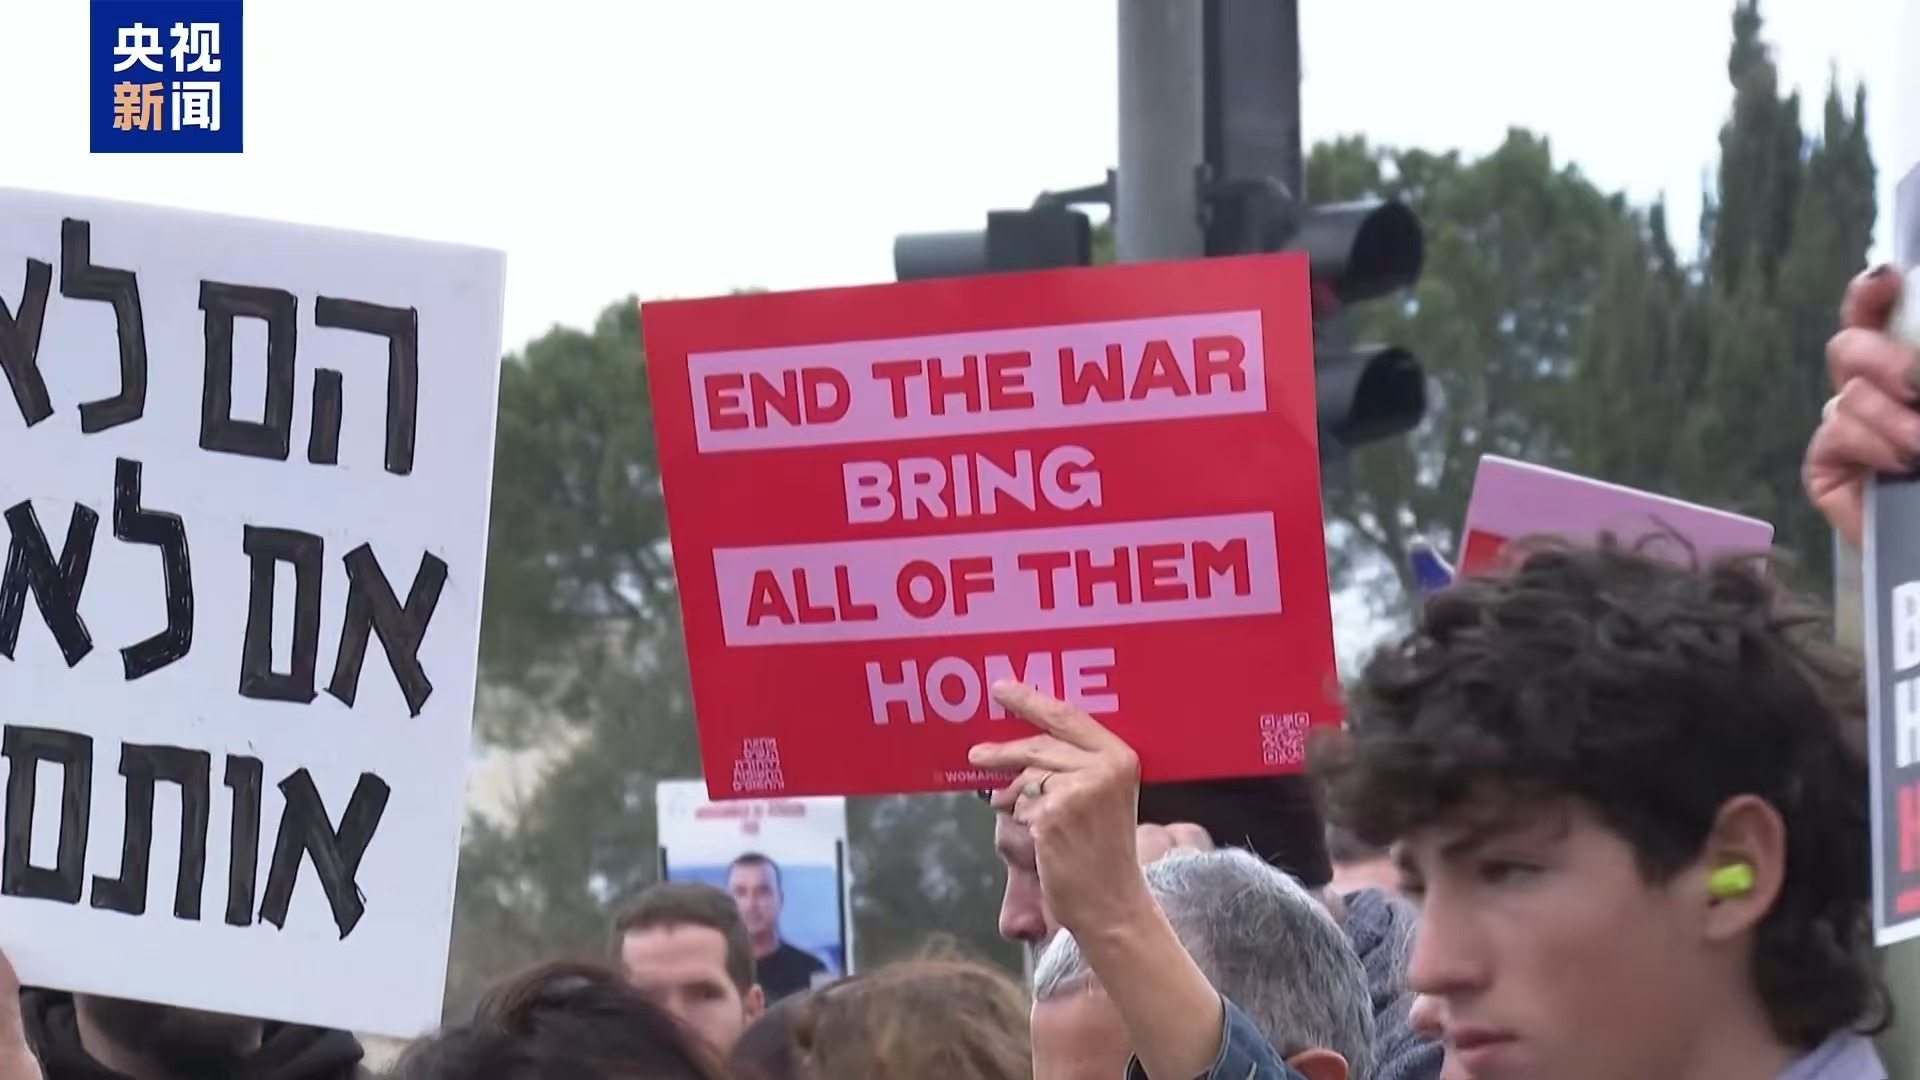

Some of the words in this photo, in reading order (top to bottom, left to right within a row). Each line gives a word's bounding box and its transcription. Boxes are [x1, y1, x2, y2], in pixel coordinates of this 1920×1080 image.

[199, 280, 418, 475] הם
[704, 367, 850, 430] END
[872, 352, 1034, 418] THE
[1059, 336, 1246, 405] WAR
[842, 445, 1102, 524] BRING
[0, 458, 193, 680] לא
[239, 524, 448, 717] אם
[746, 565, 878, 627] ALL
[896, 556, 995, 619] OF
[1018, 538, 1251, 610] THEM
[865, 648, 1119, 724] HOME
[1, 725, 390, 940] אותם
